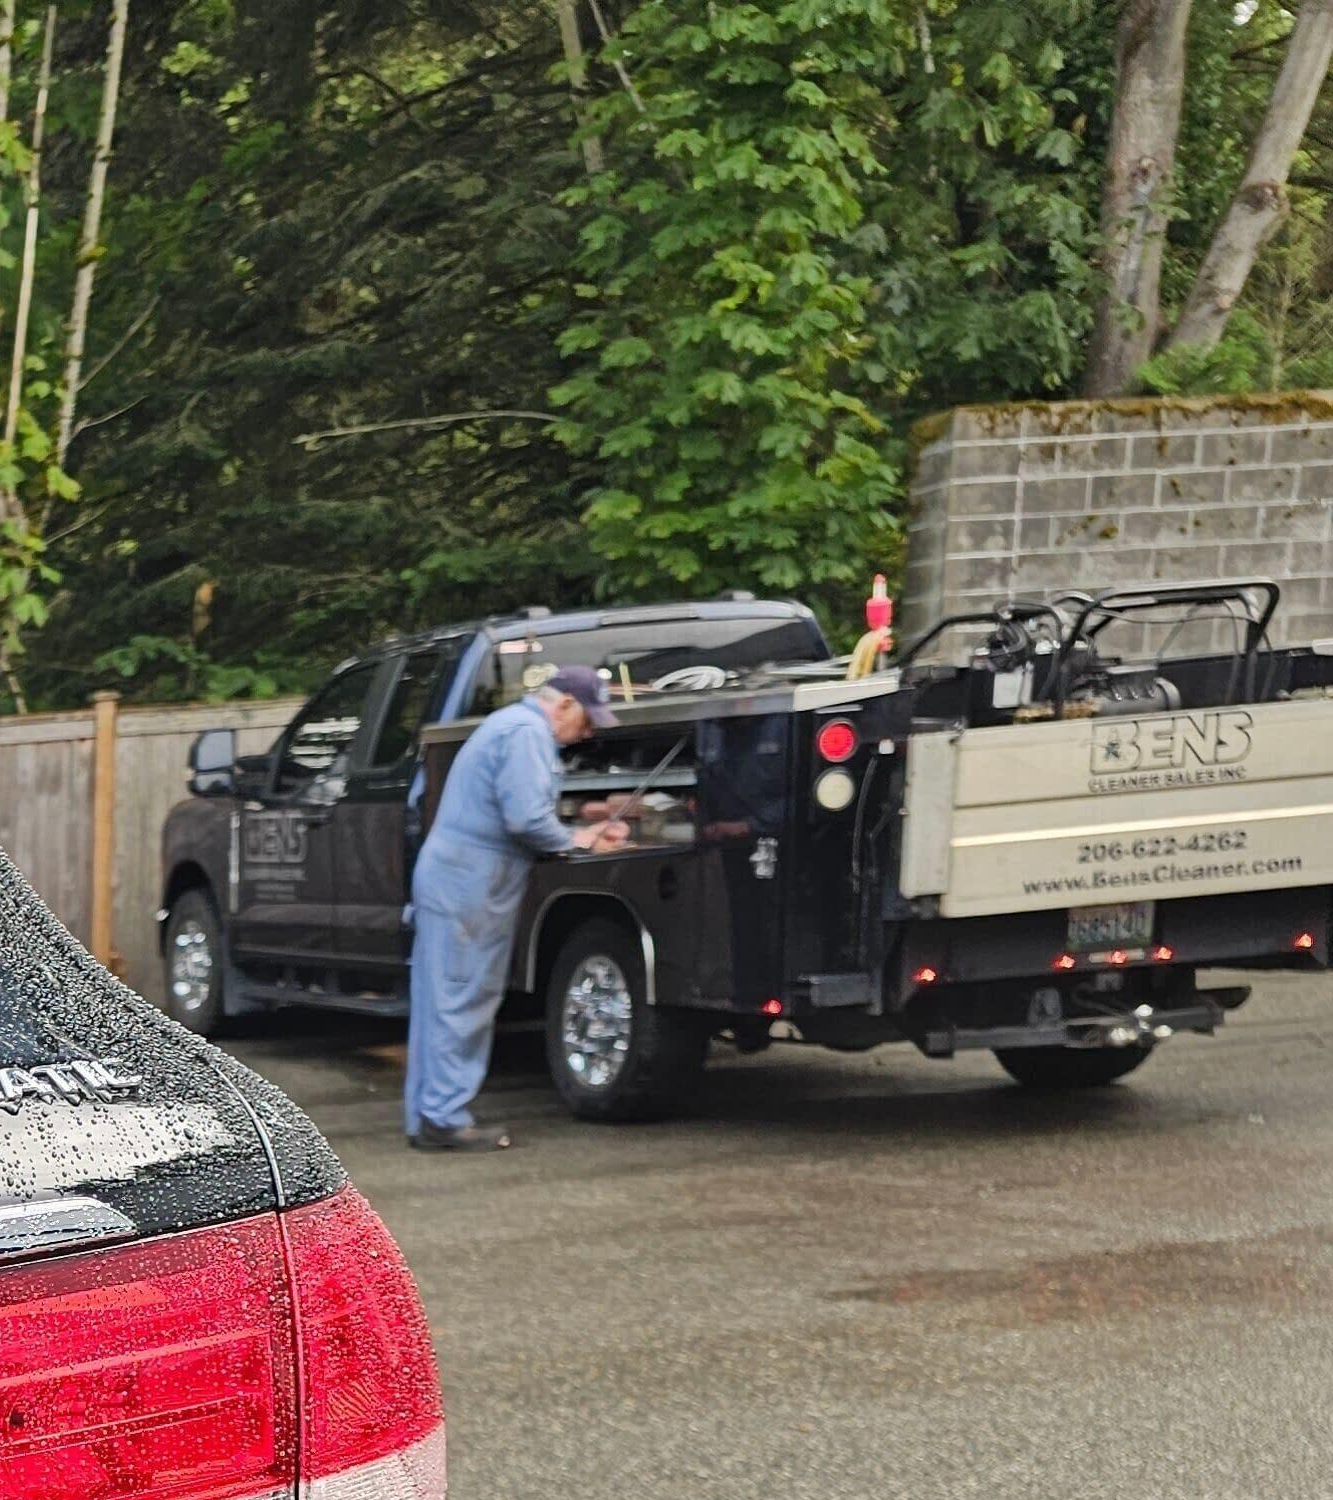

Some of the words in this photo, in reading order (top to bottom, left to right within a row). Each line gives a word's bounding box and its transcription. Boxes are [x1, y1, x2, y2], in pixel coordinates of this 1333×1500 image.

[1090, 711, 1254, 774] BENS
[1088, 775, 1160, 793] CLEANER
[1164, 768, 1215, 787] SALES
[1218, 765, 1247, 781] INC
[1078, 829, 1248, 864] 206-622-4262
